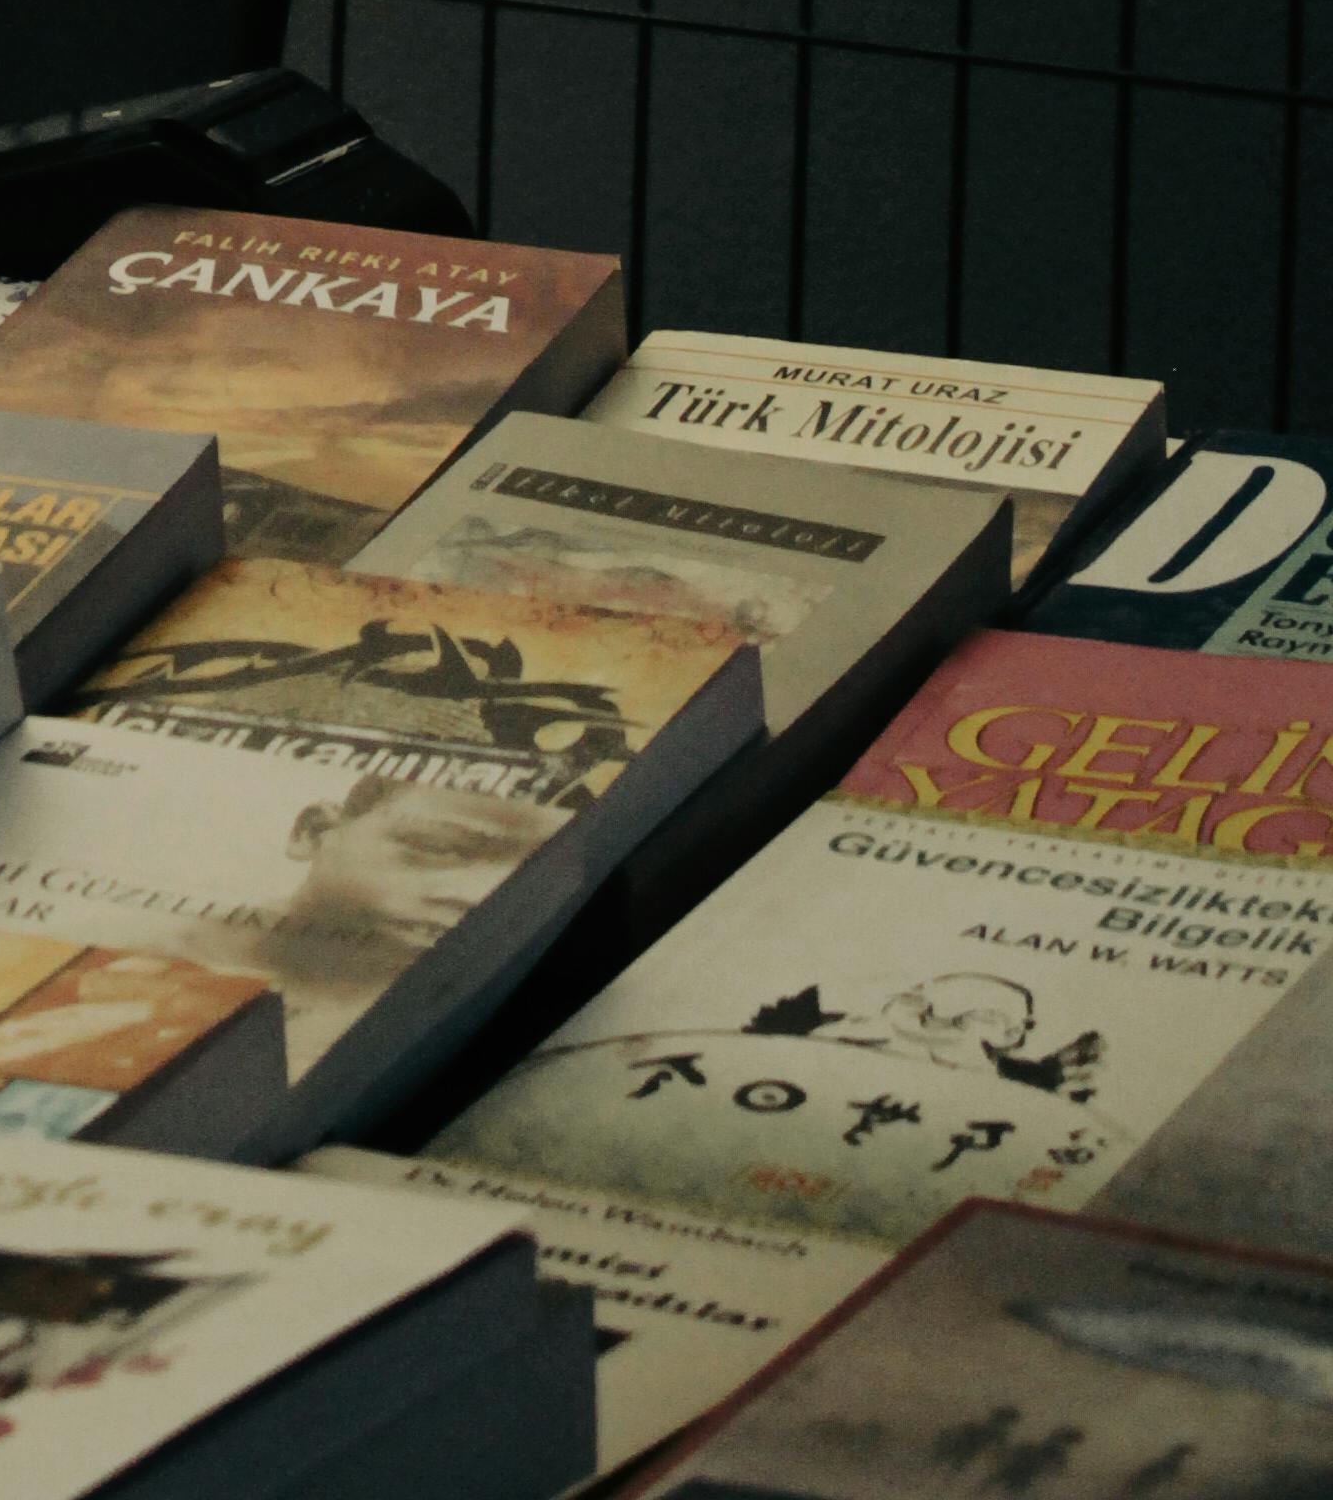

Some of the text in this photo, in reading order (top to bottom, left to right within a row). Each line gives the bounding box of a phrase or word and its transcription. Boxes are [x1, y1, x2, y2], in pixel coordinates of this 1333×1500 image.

[106, 250, 514, 334] ÇANKAYA
[297, 241, 402, 272] RIFKI
[419, 257, 523, 287] ATAY
[773, 364, 1012, 406] MURAT URAZ
[639, 379, 1085, 476] Türk Mitolojisi
[828, 831, 1333, 926] Güvencesizliktek
[959, 922, 1078, 957] ALAN
[1149, 952, 1290, 988] WATTS
[1096, 904, 1319, 956] Bilgelik
